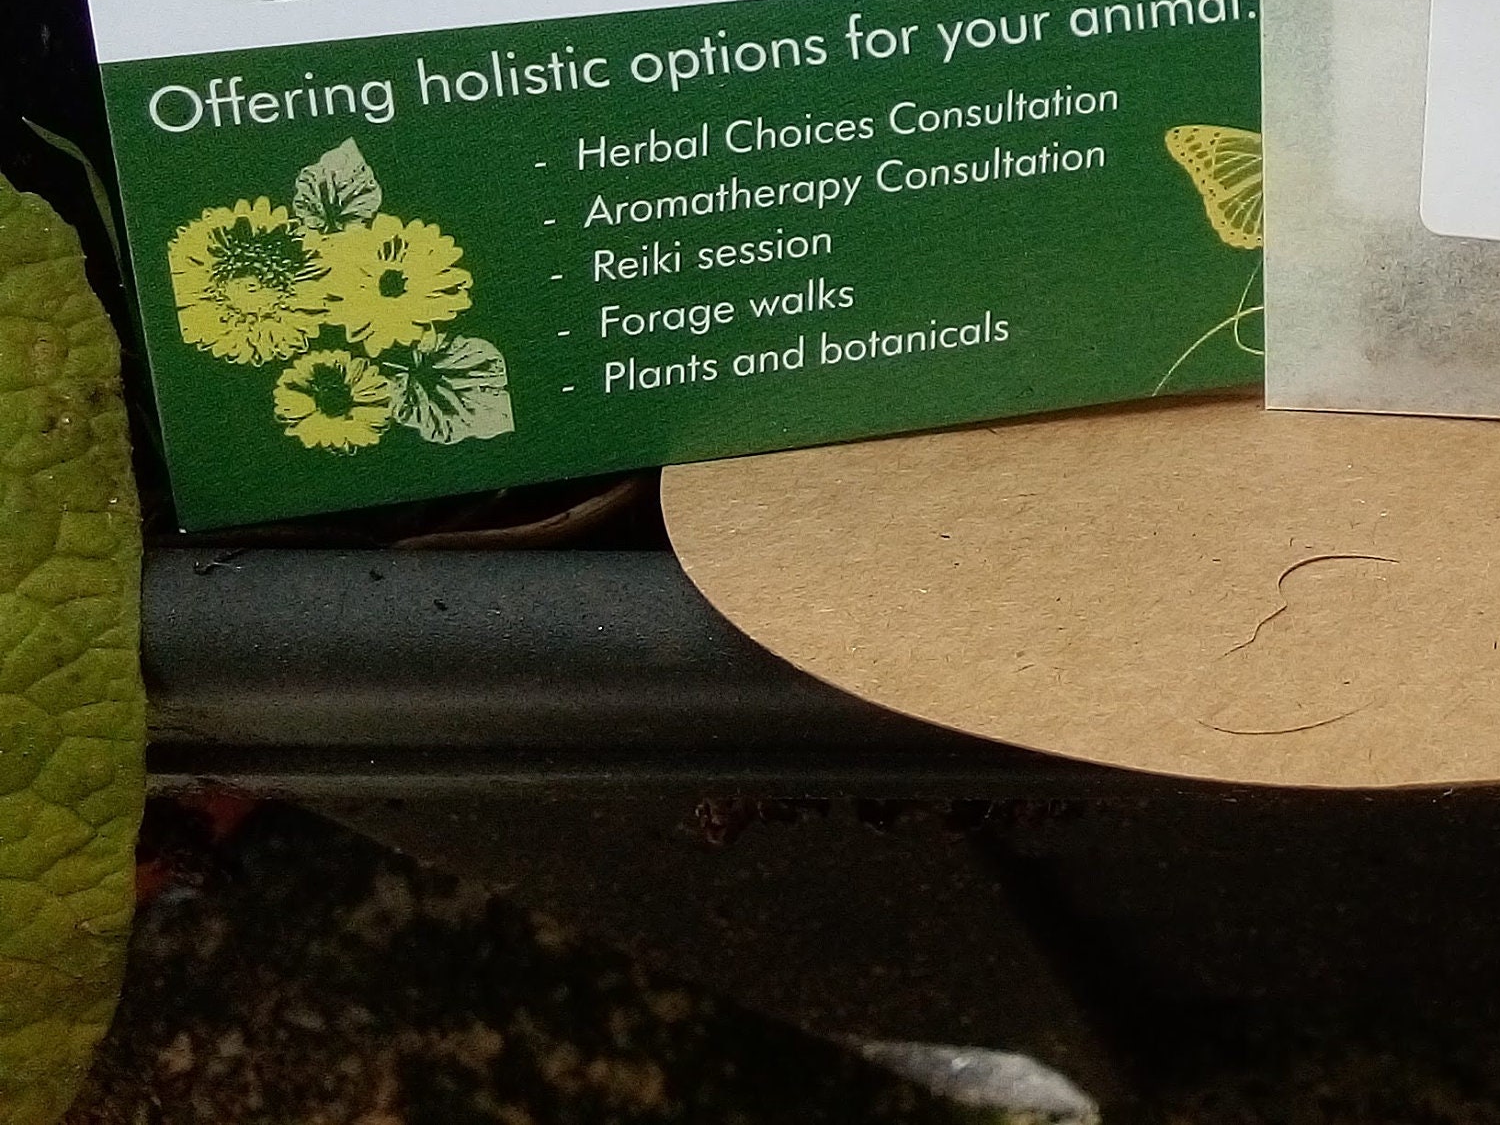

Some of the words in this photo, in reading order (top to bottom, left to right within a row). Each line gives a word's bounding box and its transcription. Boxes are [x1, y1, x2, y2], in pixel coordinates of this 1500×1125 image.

[149, 72, 396, 132] Offering
[418, 46, 609, 105] holistic
[631, 30, 828, 91] options
[847, 13, 919, 62] for
[937, 7, 1049, 63] your
[577, 121, 709, 170] Herbal
[725, 113, 875, 154] Choices
[889, 84, 1120, 134] Consultation
[583, 174, 862, 229] Aromatherapy
[876, 141, 1106, 193] Consultation
[594, 241, 683, 282] Reiki
[698, 229, 832, 270] session
[600, 297, 735, 340] Forage
[750, 277, 855, 318] walks
[604, 350, 719, 394] Plants
[733, 335, 804, 378] and
[820, 309, 1011, 366] botanicals
